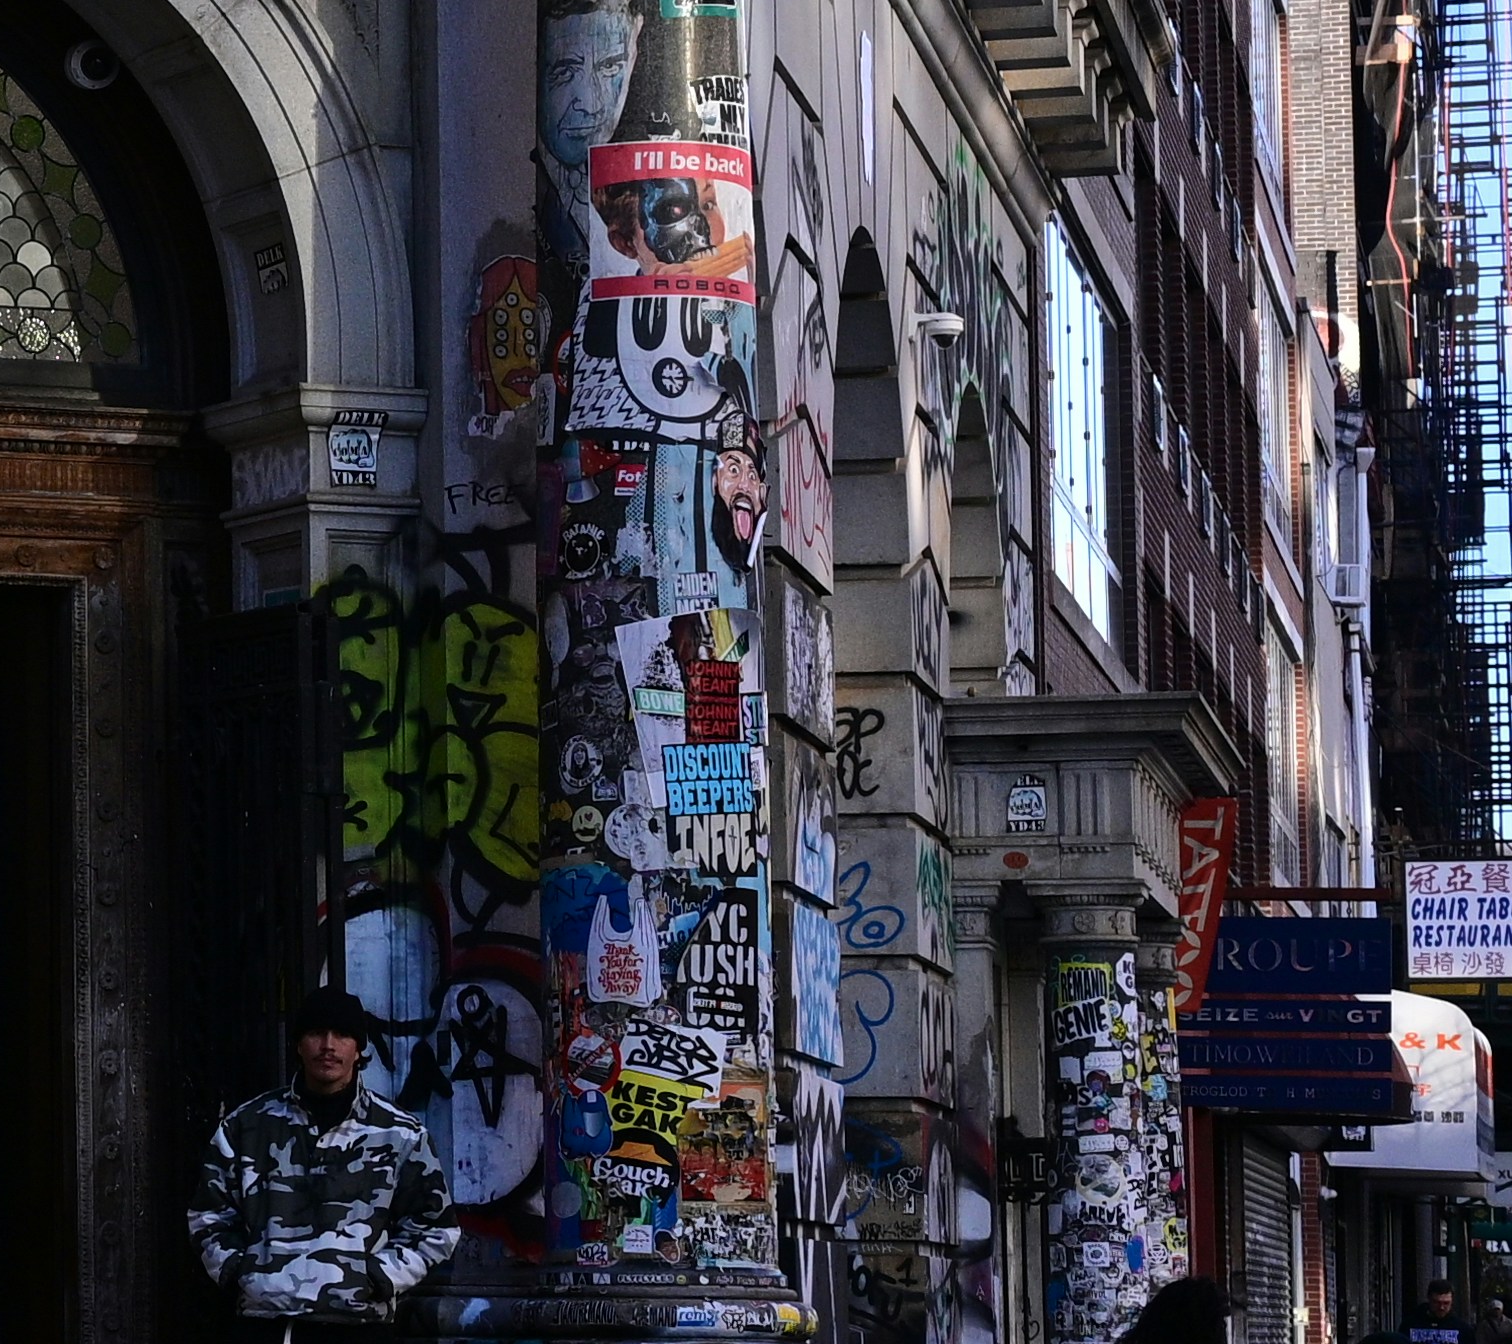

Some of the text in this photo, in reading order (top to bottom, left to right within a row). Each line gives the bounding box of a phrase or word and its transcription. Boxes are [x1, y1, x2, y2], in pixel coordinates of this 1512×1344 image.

[719, 104, 746, 136] NLY
[634, 150, 745, 178] I'll be back
[687, 661, 738, 677] JOHNNY
[688, 677, 737, 694] MEANT
[687, 705, 739, 720] JOHNNY
[689, 721, 737, 737] MEANT
[664, 743, 750, 782] DISCOUNT
[667, 779, 755, 816] BEEPERS
[1411, 896, 1512, 922] CHAIR TAB
[696, 902, 748, 944] YC
[603, 943, 636, 956] Thank
[1217, 937, 1383, 973] ROUPE
[599, 956, 622, 969] You
[598, 968, 643, 983] Staying
[603, 980, 641, 995] Away!
[1177, 1008, 1259, 1023] SEIZE
[610, 1080, 695, 1116] KEST
[611, 1103, 684, 1136] GAK
